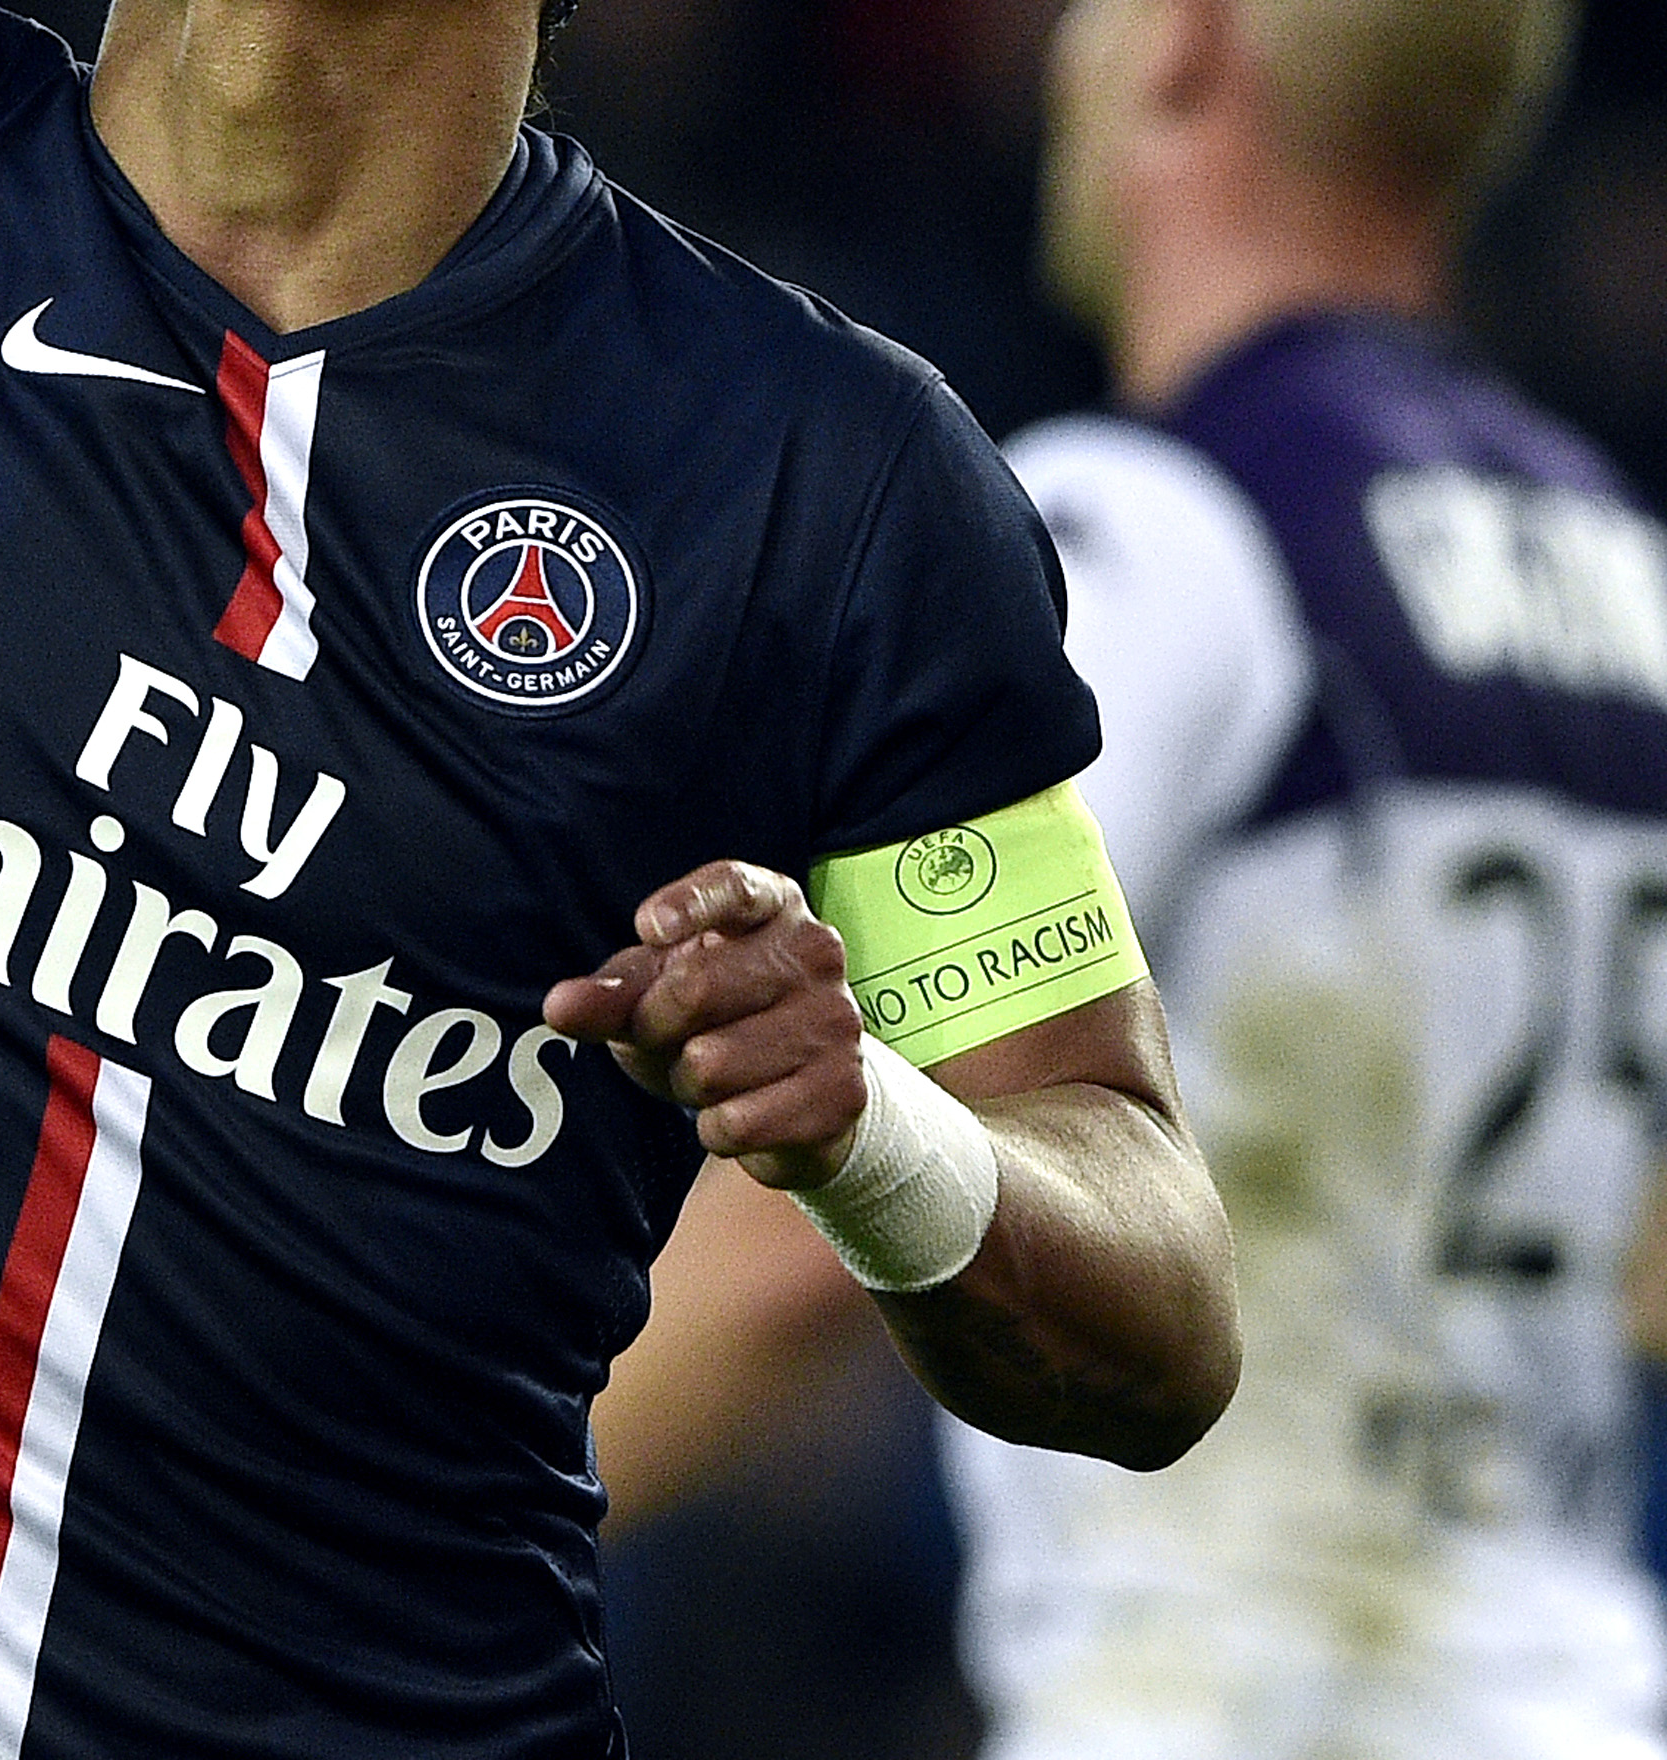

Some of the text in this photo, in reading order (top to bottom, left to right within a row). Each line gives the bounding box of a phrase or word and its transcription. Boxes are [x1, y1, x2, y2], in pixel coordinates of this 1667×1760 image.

[459, 508, 606, 564] PARIS
[436, 615, 612, 692] SAINT-GERMAIN
[74, 652, 348, 901] Fly
[907, 830, 965, 862] UEFA
[908, 963, 970, 1011] TO
[976, 905, 1114, 986] RACISM
